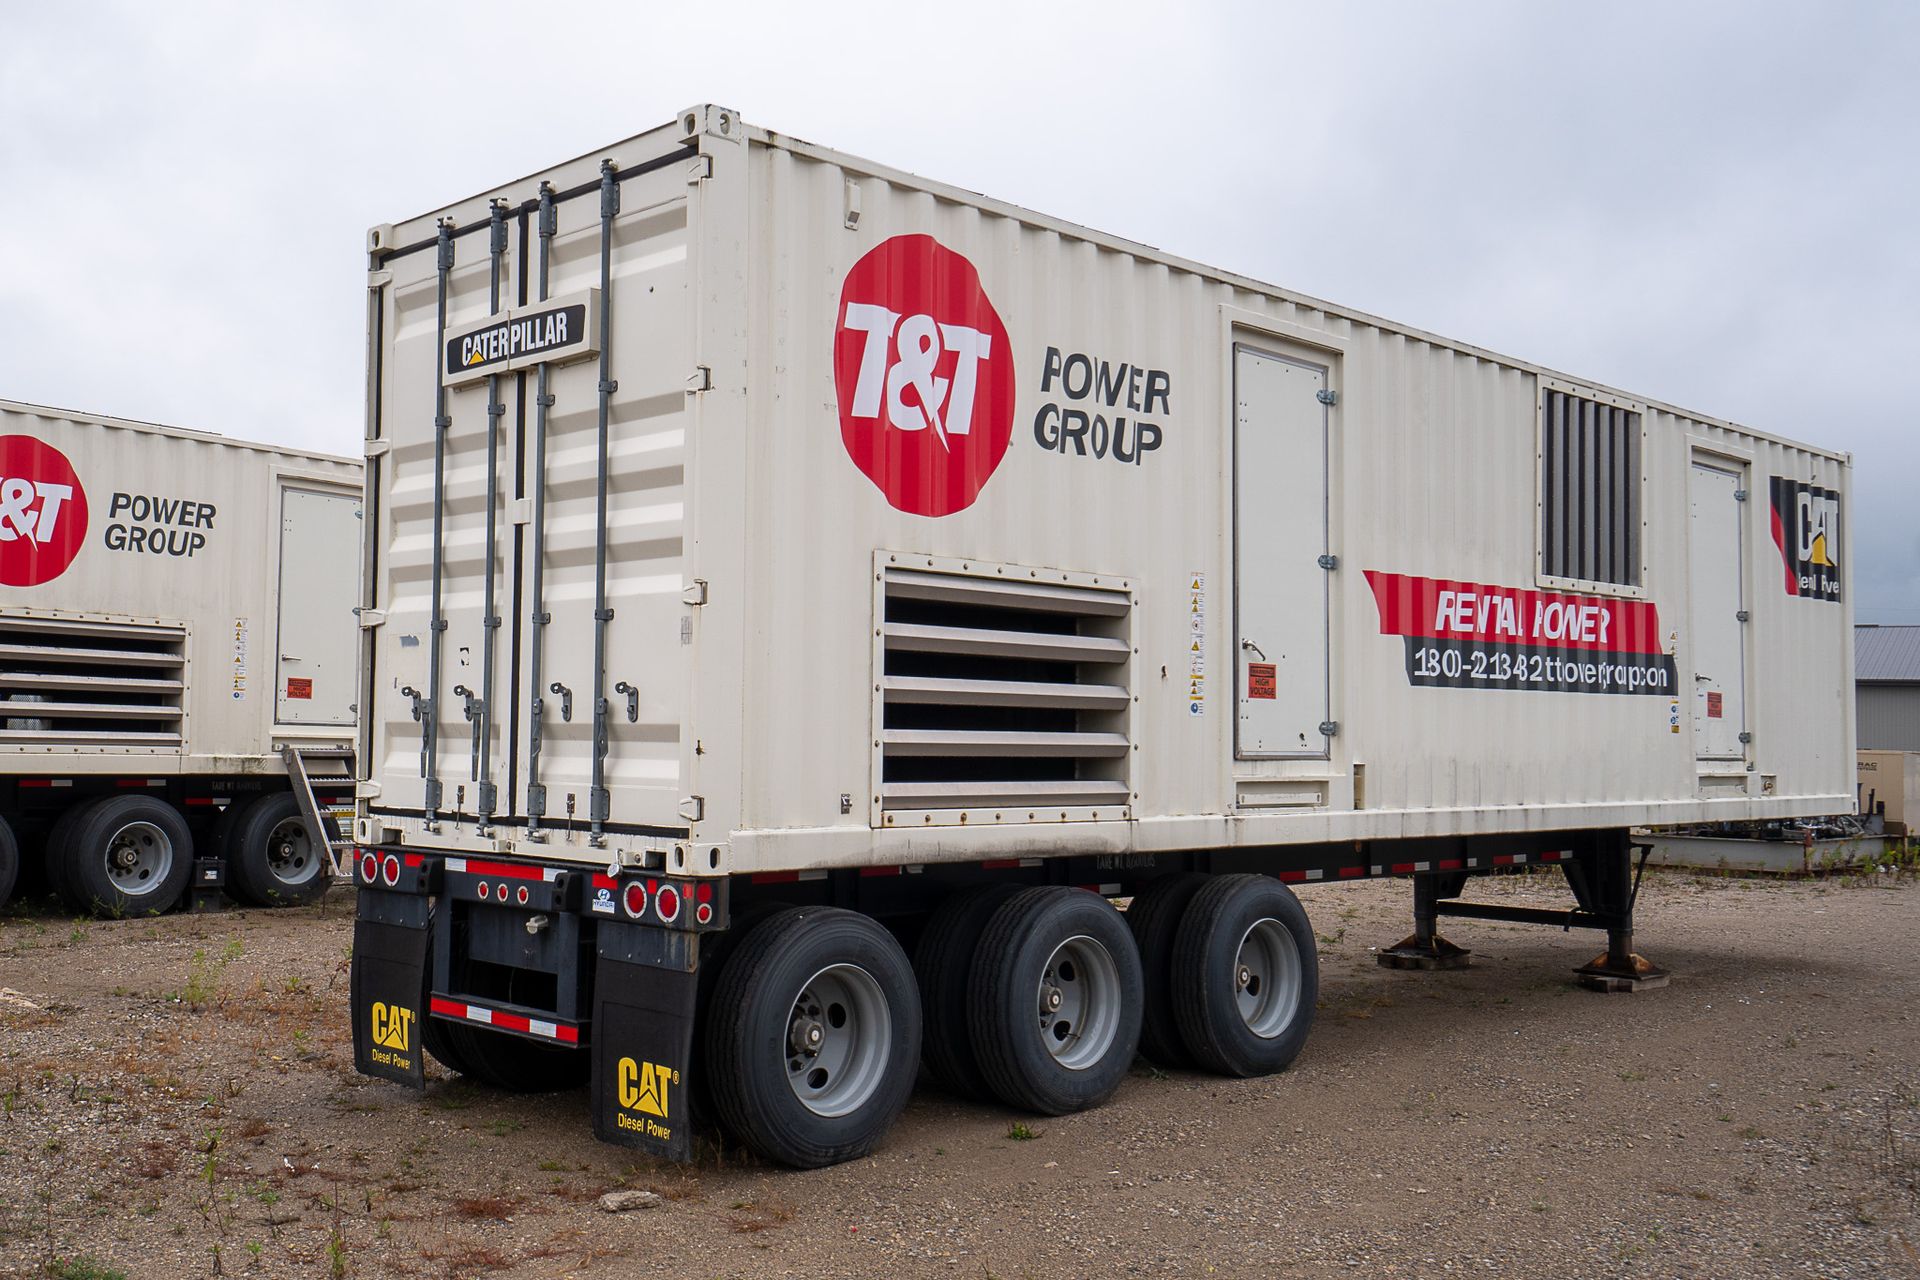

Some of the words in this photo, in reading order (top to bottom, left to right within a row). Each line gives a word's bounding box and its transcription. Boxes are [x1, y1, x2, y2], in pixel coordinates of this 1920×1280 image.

[462, 312, 567, 367] CATERPILLAR
[844, 302, 992, 453] T&T
[1040, 346, 1170, 415] POWER
[1034, 403, 1163, 466] GROUP
[0, 476, 73, 552] &T
[109, 492, 217, 529] POWER
[1797, 492, 1839, 567] CAT
[104, 524, 206, 557] GROUP
[372, 1048, 392, 1065] Diesel
[392, 1053, 411, 1070] Power
[618, 1112, 645, 1133] Diesel
[647, 1119, 671, 1140] Power
